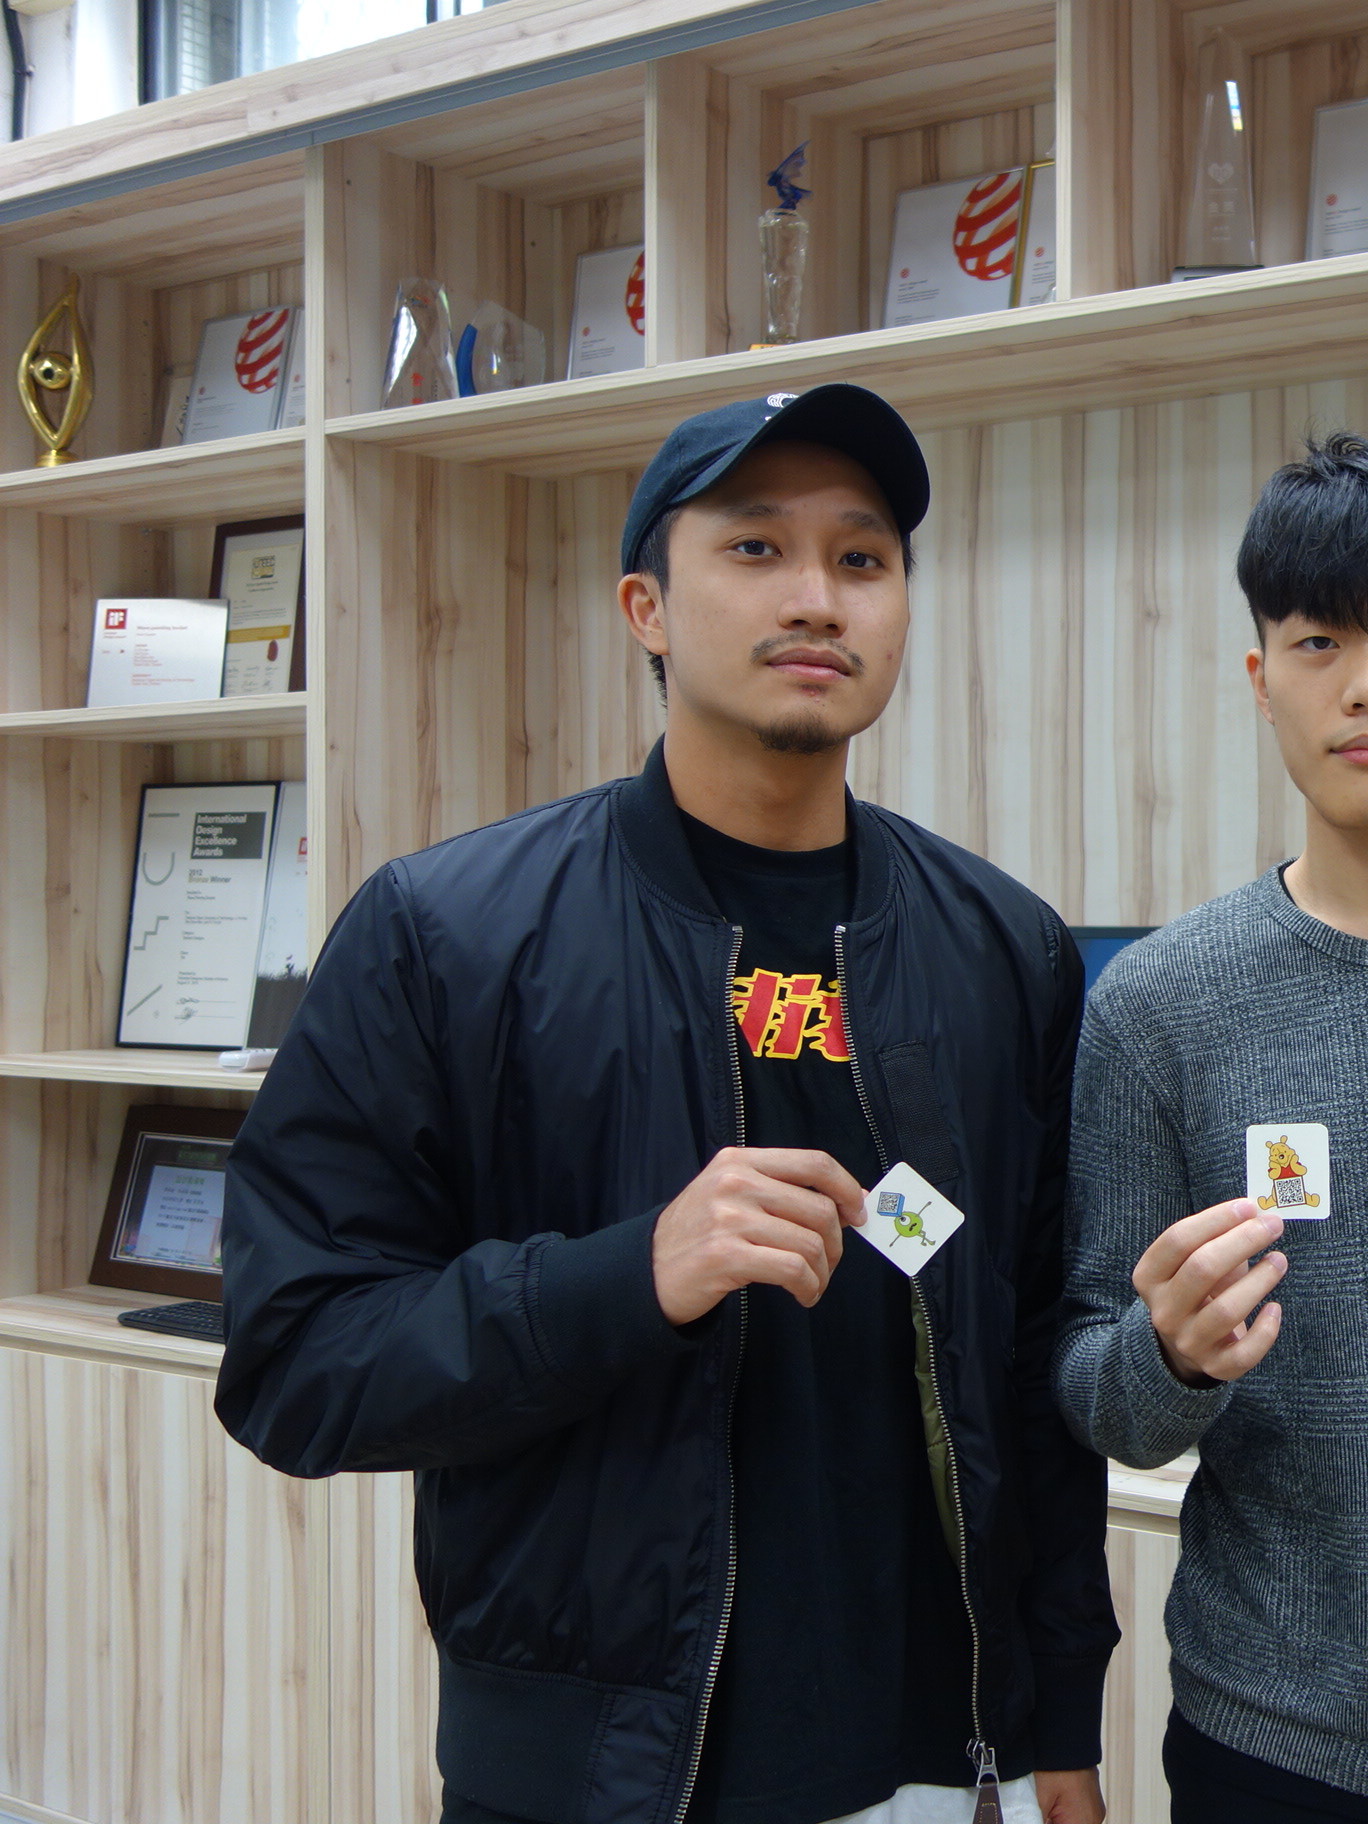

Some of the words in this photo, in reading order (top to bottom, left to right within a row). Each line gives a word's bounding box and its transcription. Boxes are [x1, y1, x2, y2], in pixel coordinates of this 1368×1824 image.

[197, 813, 247, 824] International
[196, 825, 223, 836] Design
[195, 836, 238, 846] Excellence
[193, 847, 223, 857] Awards
